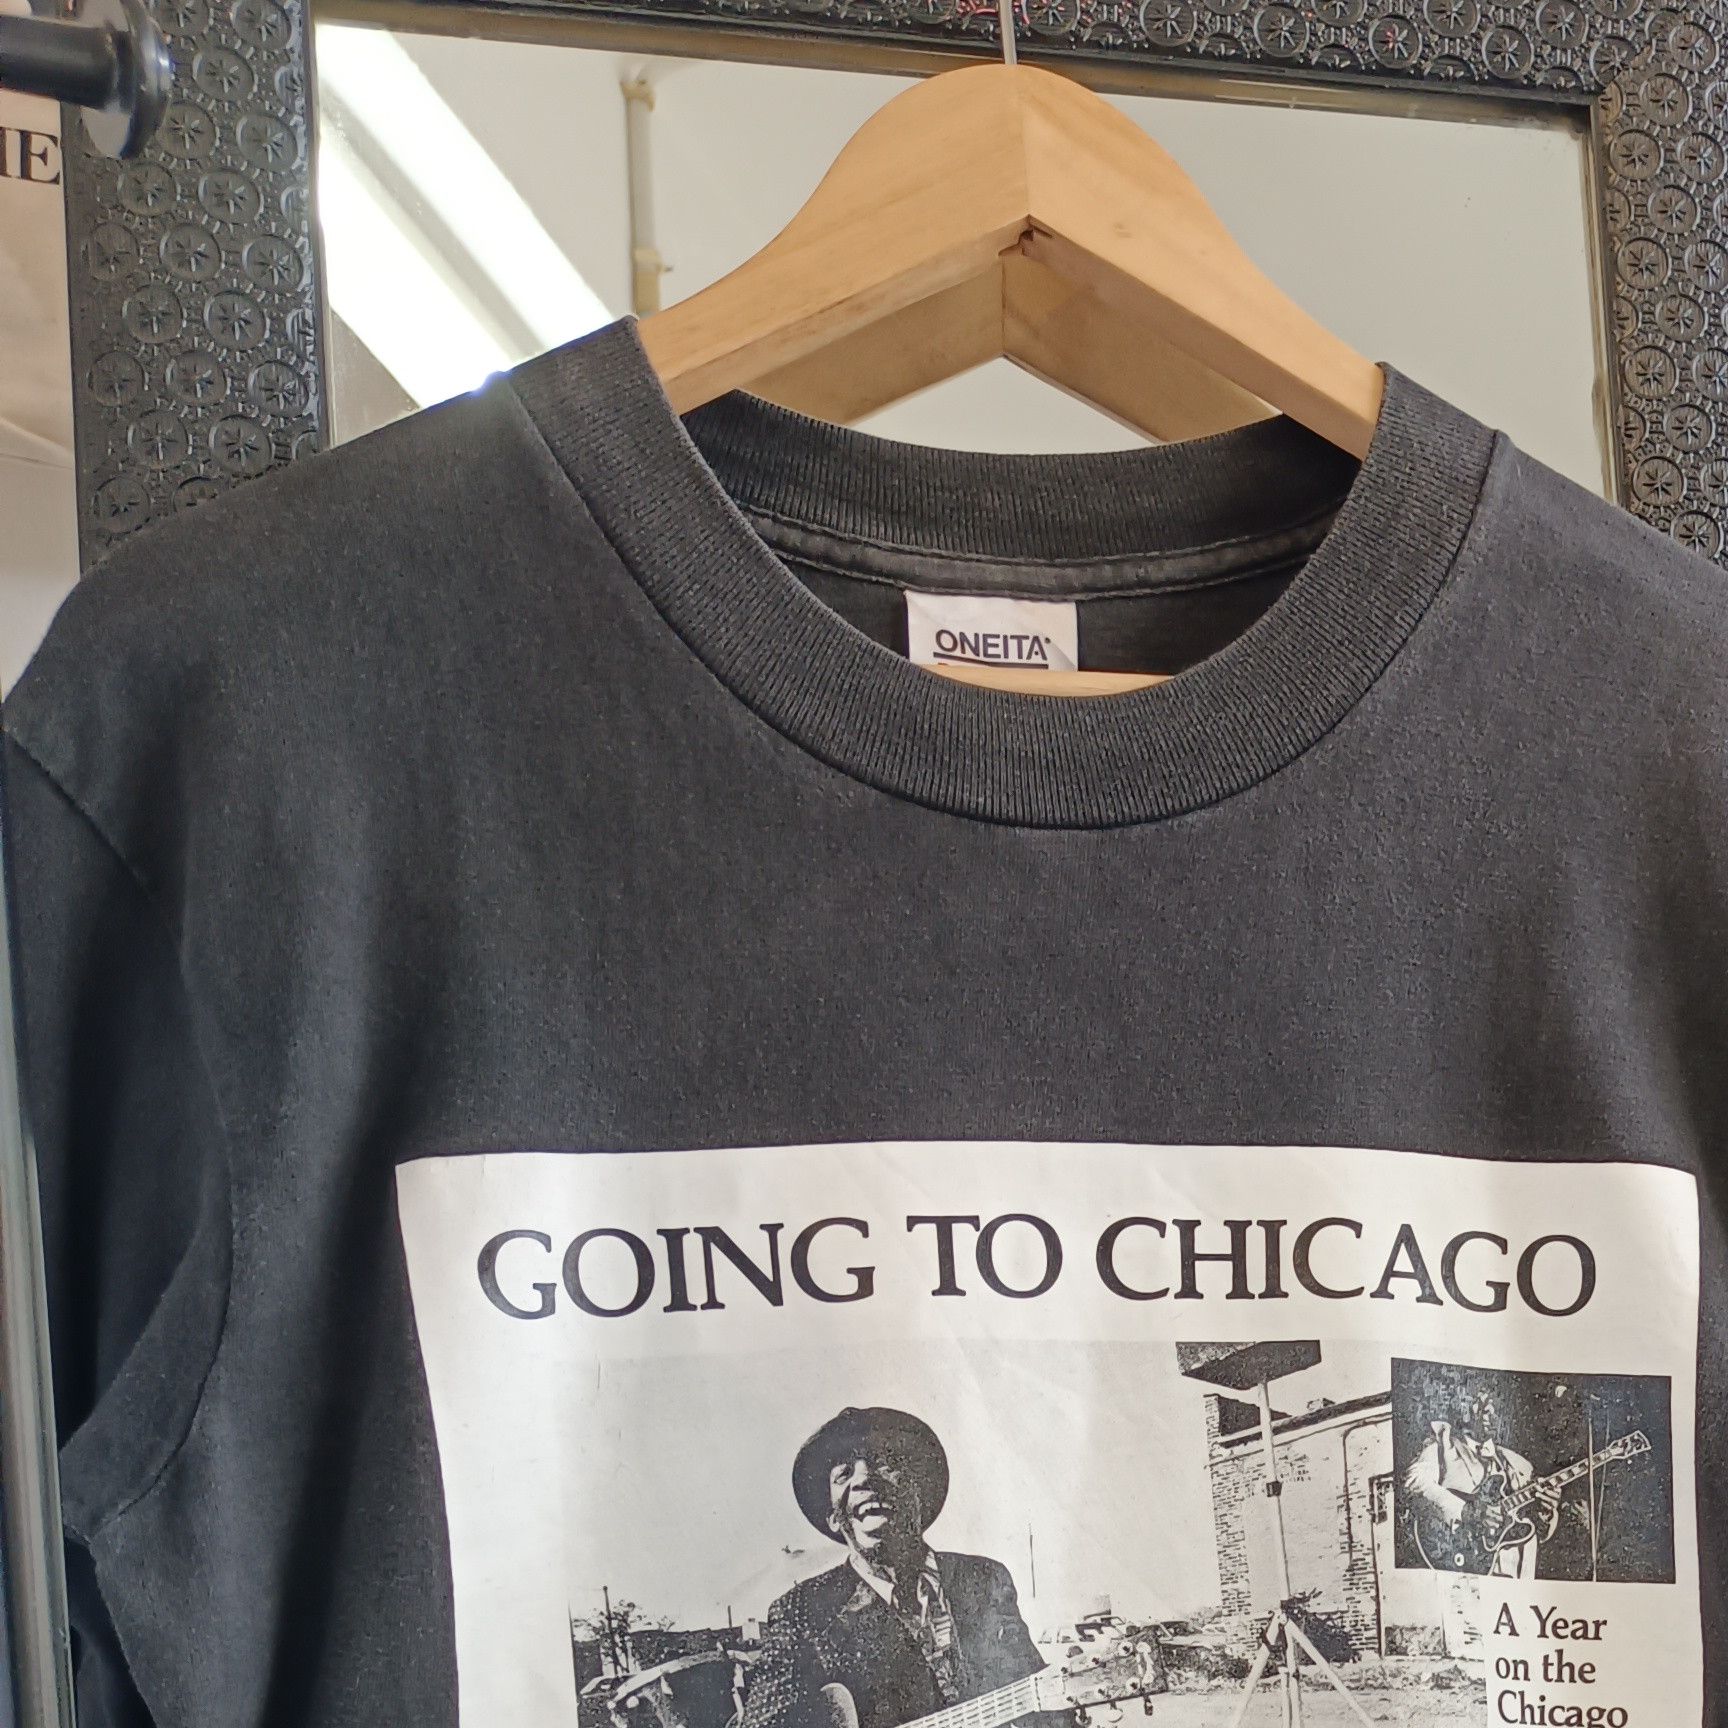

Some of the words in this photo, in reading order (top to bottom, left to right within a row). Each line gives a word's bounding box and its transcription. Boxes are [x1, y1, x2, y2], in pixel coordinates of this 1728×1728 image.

[935, 629, 1047, 660] ONEITA
[477, 1218, 875, 1320] GOING
[905, 1214, 1062, 1298] TO
[1097, 1216, 1597, 1317] CHICAGO
[1494, 1602, 1520, 1637] A
[1530, 1605, 1607, 1641] Year
[1495, 1656, 1530, 1682] on
[1542, 1648, 1596, 1684] the
